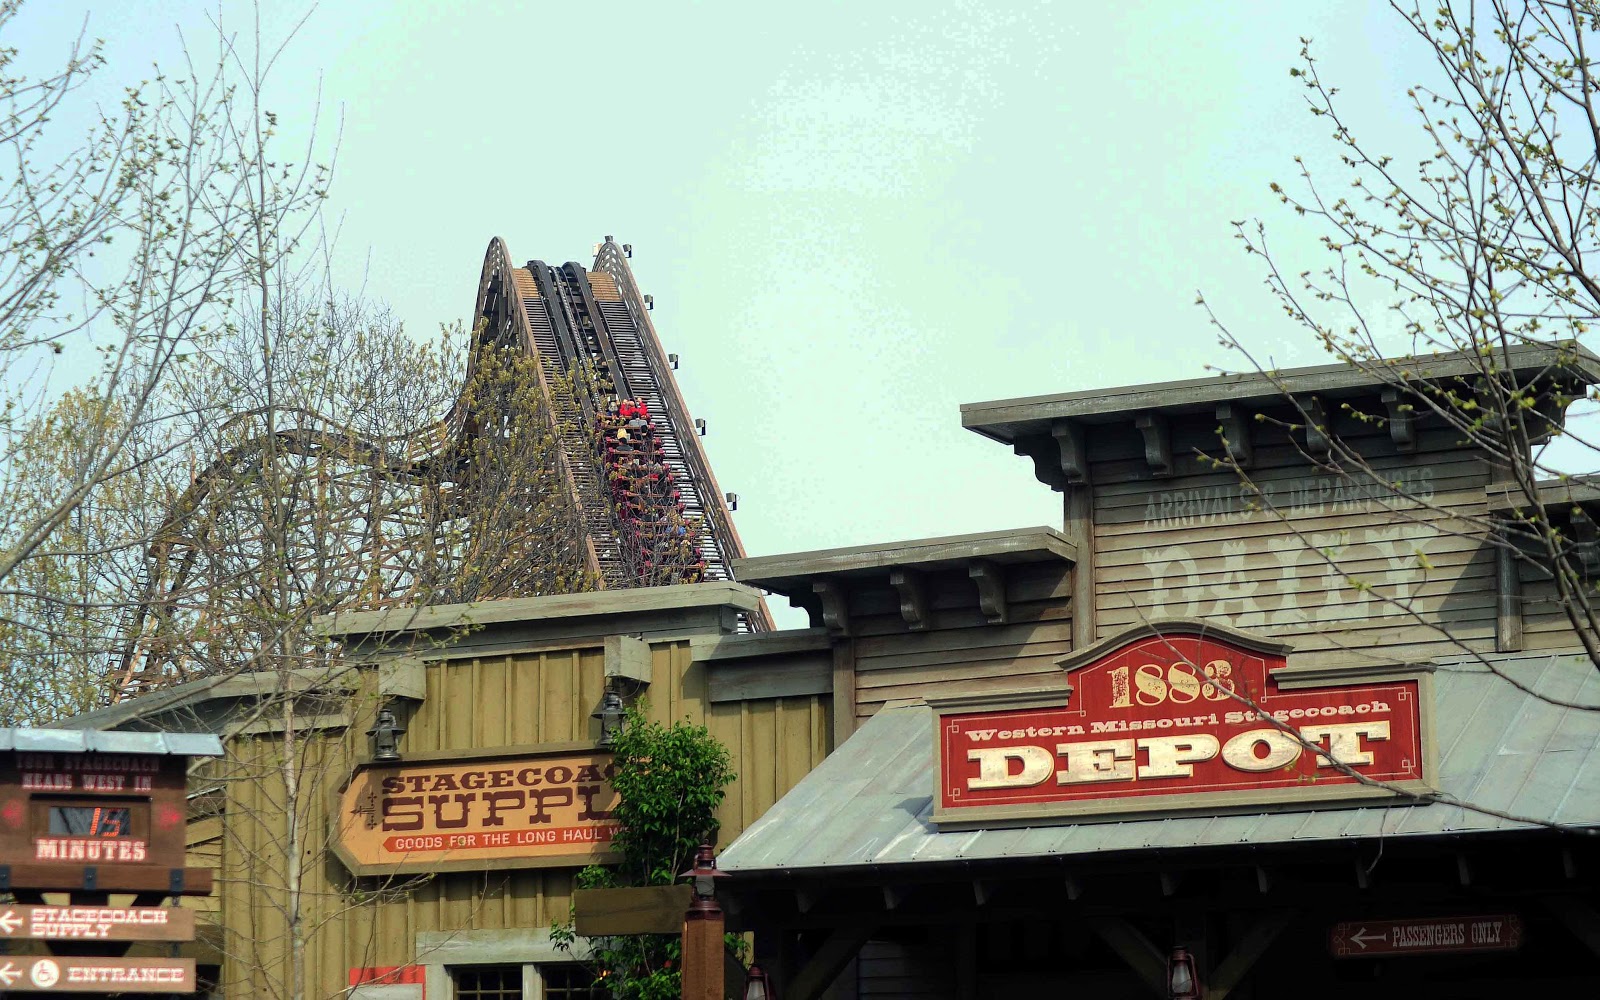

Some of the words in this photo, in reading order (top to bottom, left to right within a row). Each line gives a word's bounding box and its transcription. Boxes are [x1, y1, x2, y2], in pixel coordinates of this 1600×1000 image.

[1144, 485, 1253, 528] ARRIVALS
[1288, 466, 1436, 516] DEPARTURES
[1142, 524, 1440, 631] DAILY
[1107, 659, 1236, 709] 1883
[964, 725, 1086, 742] Western
[1090, 713, 1220, 734] Missouri
[1224, 700, 1392, 724] Stagecoach
[967, 719, 1391, 792] DEPOT
[22, 773, 73, 790] HEADS
[83, 774, 126, 791] WEST
[134, 775, 152, 791] IN
[90, 807, 121, 837] 15
[382, 784, 618, 832] SUPPL
[36, 839, 146, 861] MINUTES
[395, 836, 443, 850] GOODS
[449, 834, 476, 848] FOR
[482, 833, 511, 846] THE
[517, 830, 556, 844] LONG
[563, 827, 603, 842] HAUL
[31, 908, 168, 924] STAGECOACH
[31, 923, 112, 937] SUPPLY
[1392, 922, 1465, 947] PASSENGERS
[1471, 921, 1502, 944] ONLY
[67, 967, 185, 982] ENTRANCE
